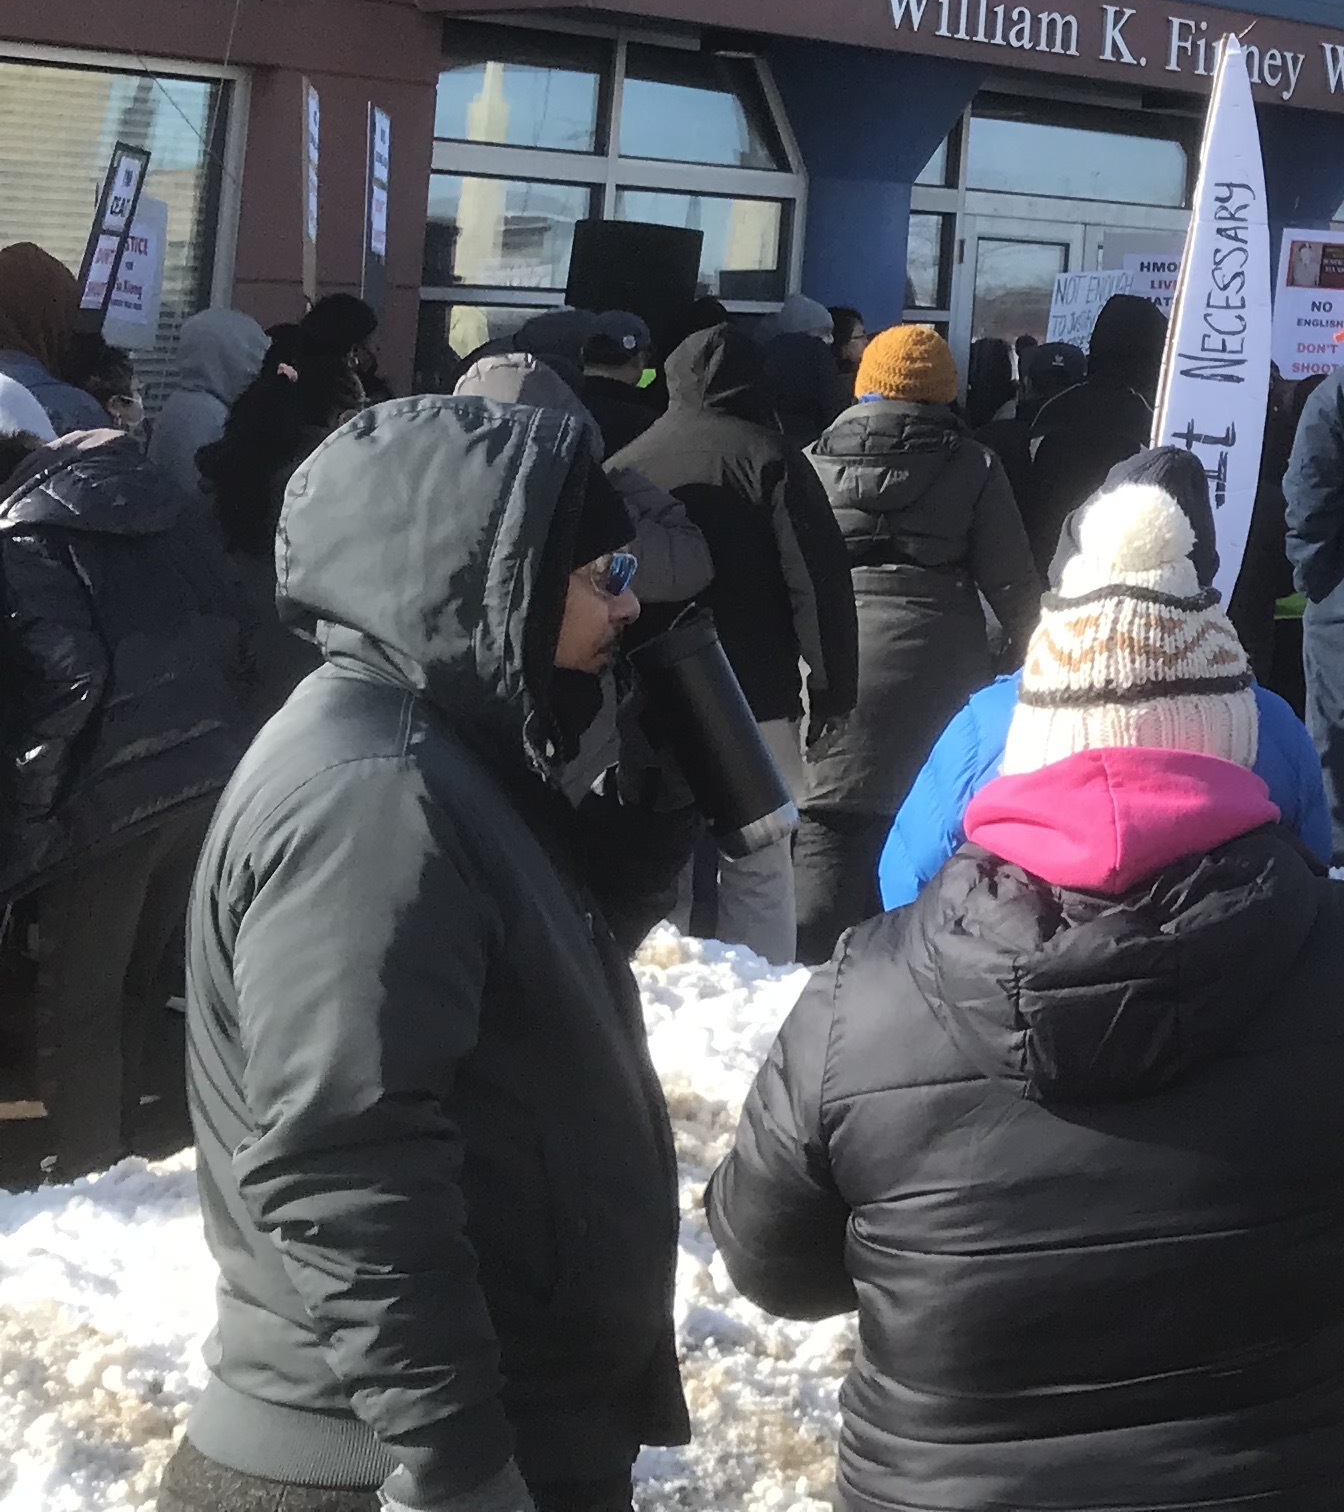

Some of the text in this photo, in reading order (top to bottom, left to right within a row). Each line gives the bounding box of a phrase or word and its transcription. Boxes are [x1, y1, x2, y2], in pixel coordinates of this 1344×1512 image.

[1099, 4, 1147, 67] K.
[1140, 261, 1182, 273] HMO
[1178, 182, 1257, 384] NECESSARY
[1055, 275, 1087, 305] NOT
[1311, 301, 1333, 313] NO
[1296, 318, 1344, 329] ENGLISH
[1297, 342, 1339, 354] DON'T
[1292, 362, 1340, 374] SHOOT
